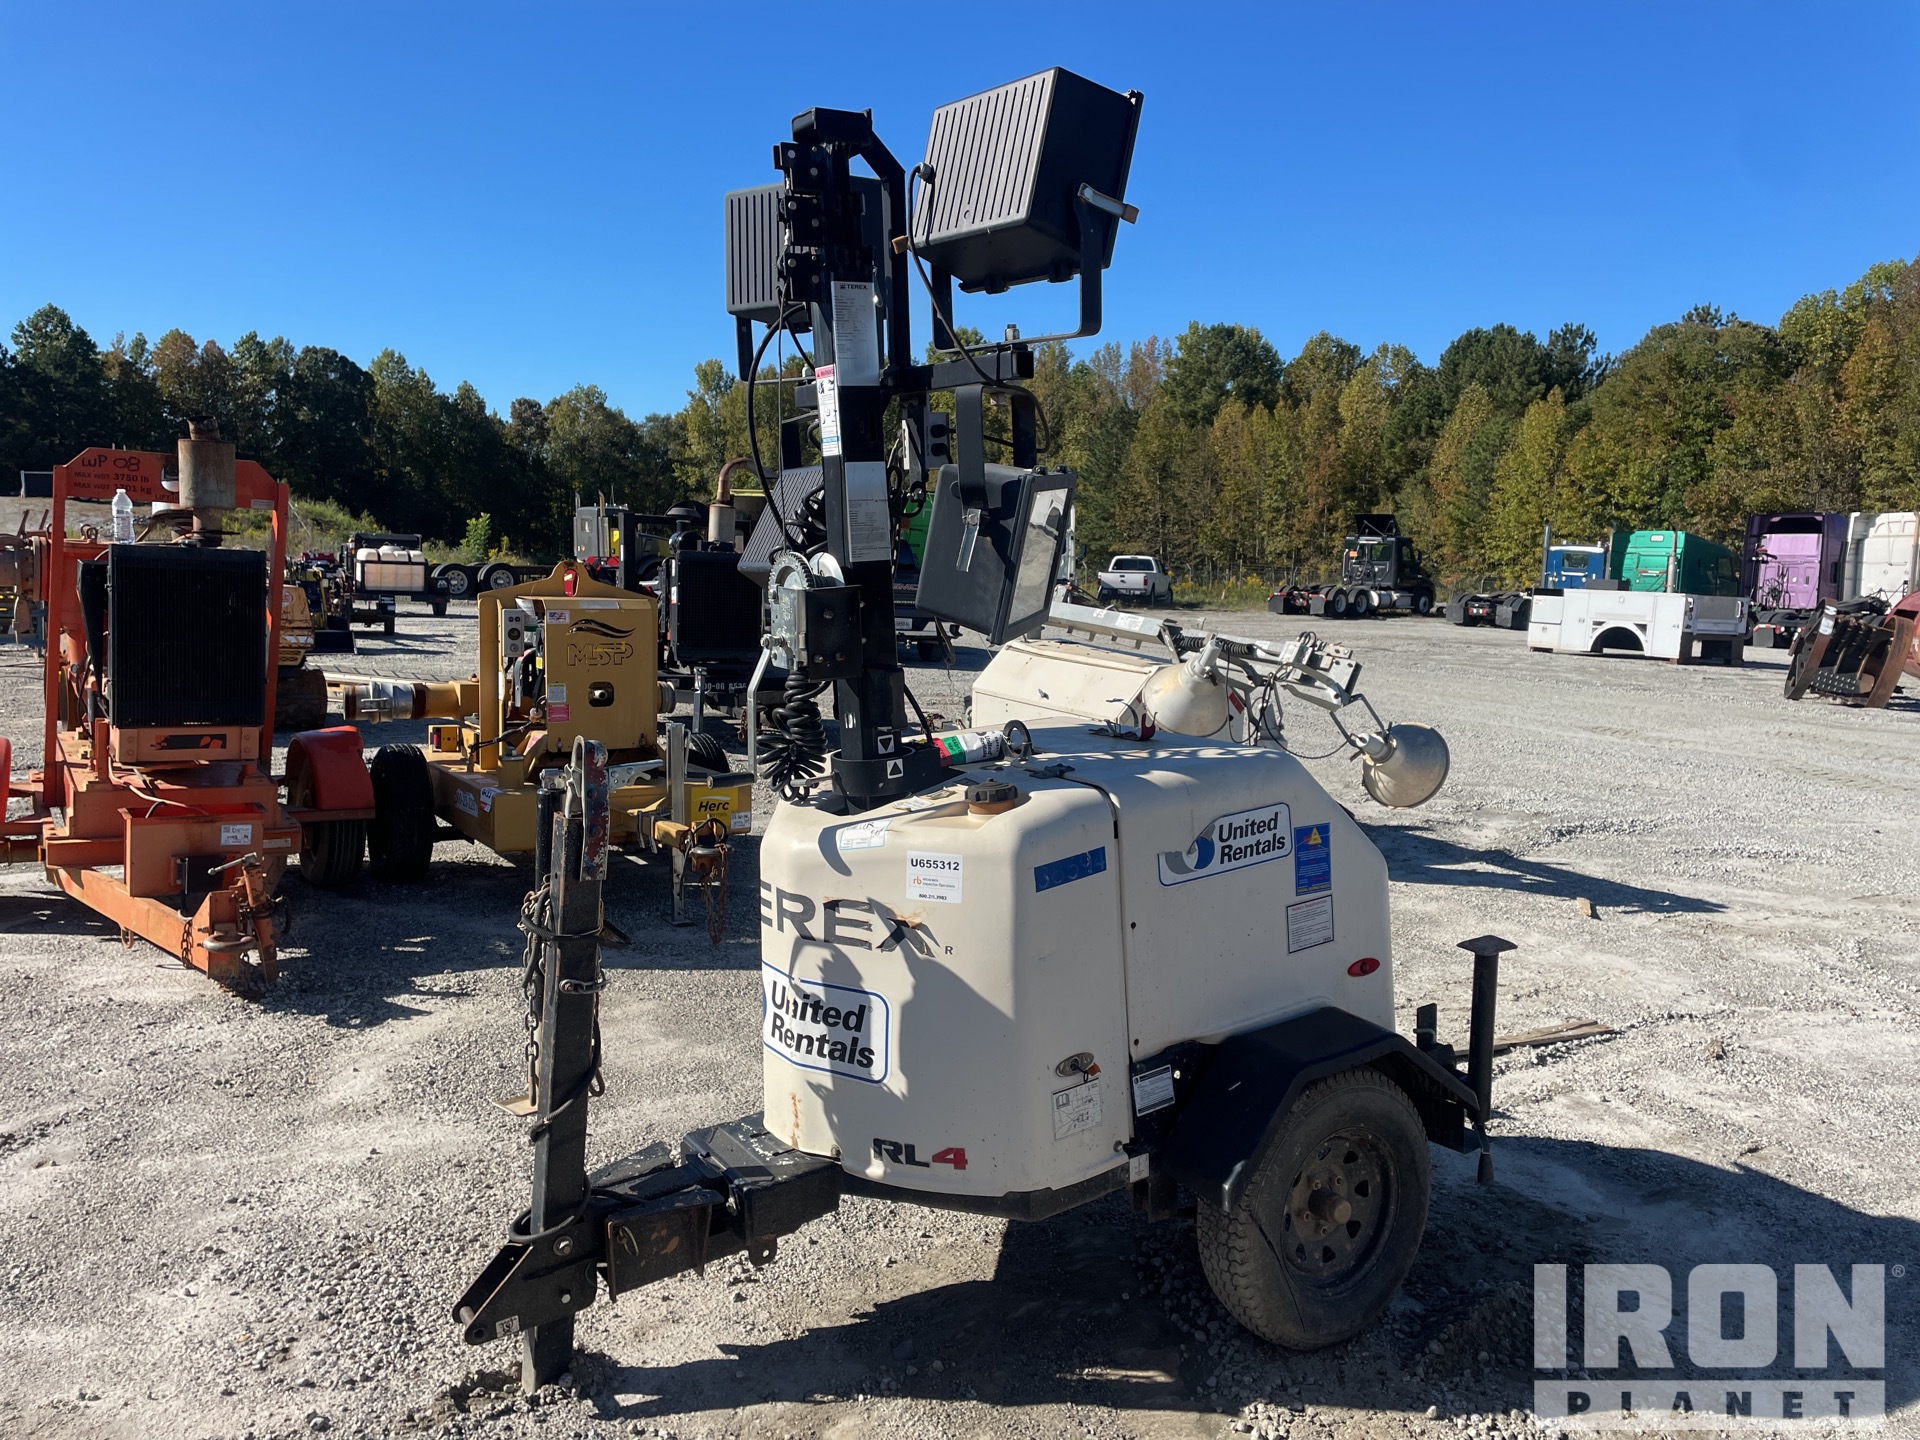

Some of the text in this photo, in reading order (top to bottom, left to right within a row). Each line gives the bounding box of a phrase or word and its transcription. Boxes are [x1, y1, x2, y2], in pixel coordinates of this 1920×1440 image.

[113, 457, 140, 472] 08
[113, 473, 138, 481] 3750
[567, 643, 634, 666] MSP
[698, 801, 730, 813] Herc
[1218, 811, 1279, 843] United
[1220, 833, 1286, 865] Rentals
[910, 858, 960, 871] U655312
[771, 980, 867, 1033] United
[771, 1011, 876, 1069] Rentals
[873, 1137, 968, 1171] RL4
